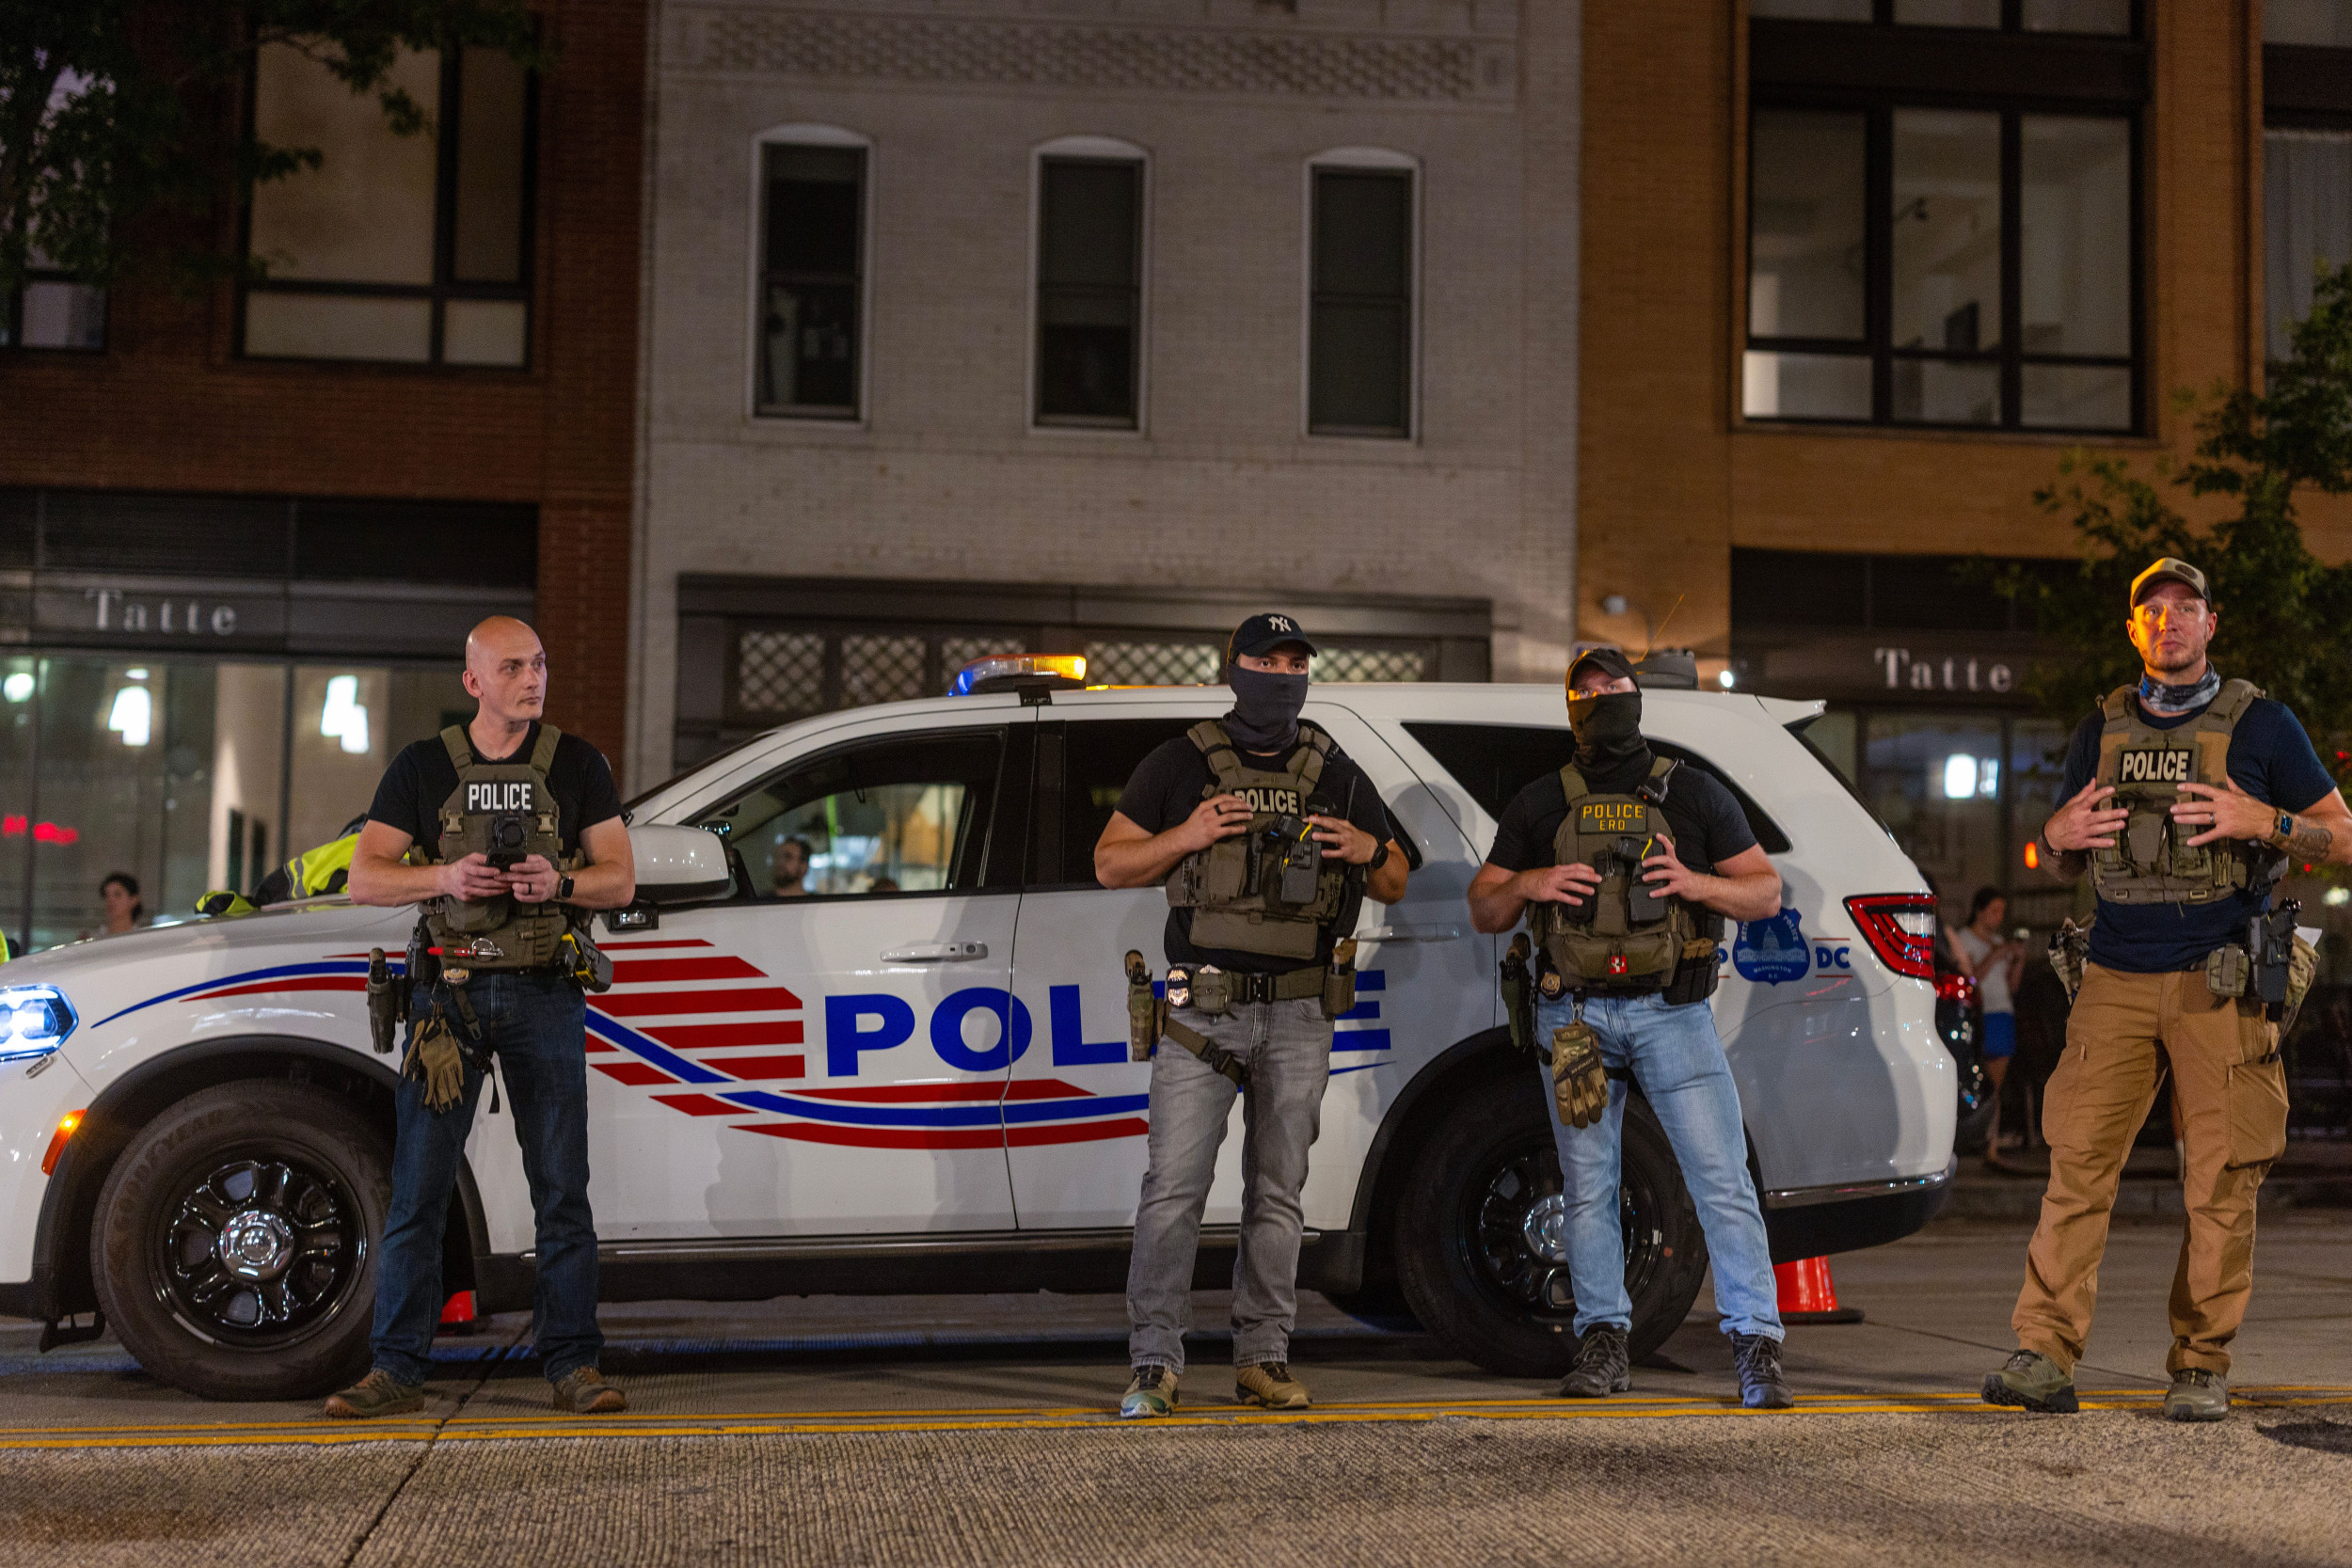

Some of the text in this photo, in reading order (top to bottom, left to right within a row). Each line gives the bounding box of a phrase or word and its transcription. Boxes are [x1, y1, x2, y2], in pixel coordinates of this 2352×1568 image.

[86, 589, 236, 636] Tatte
[1874, 647, 2013, 692] Tatte
[2122, 751, 2189, 782] POLICE
[469, 784, 532, 810] POLICE
[1582, 803, 1644, 819] POLICE
[1599, 819, 1626, 832] ERO
[1753, 964, 1792, 974] WASHINGTON
[1815, 946, 1851, 969] DC
[825, 970, 1392, 1077] POLE
